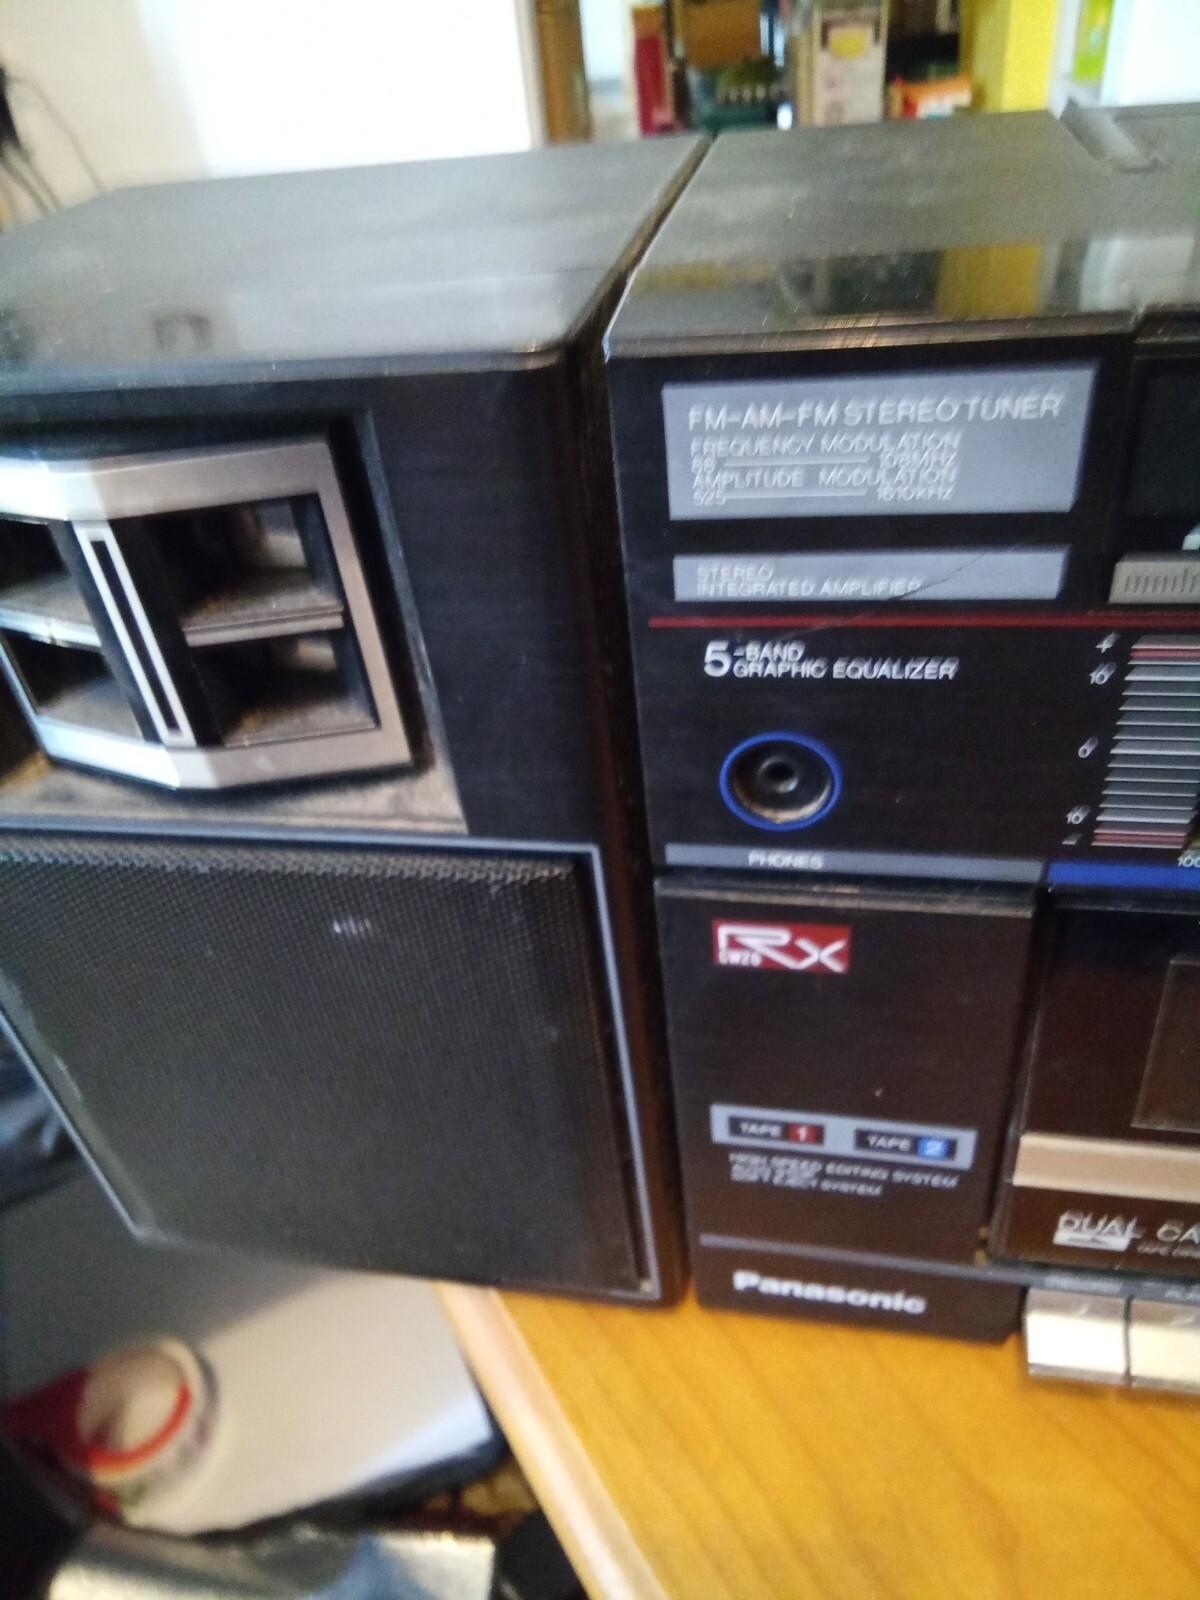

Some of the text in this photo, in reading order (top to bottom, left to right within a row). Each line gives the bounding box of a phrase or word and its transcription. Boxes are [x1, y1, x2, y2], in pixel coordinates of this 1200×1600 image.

[843, 394, 959, 427] STEREO
[961, 389, 1065, 422] TUNER
[691, 429, 962, 457] FREQUENCY MODULATION
[693, 462, 959, 489] AMPLITUDE MODULATION
[697, 565, 773, 582] STEREO
[697, 577, 923, 597] INTEGRATED AMPLIFIER
[733, 656, 960, 680] GRAPHIC EQUALIZER
[747, 851, 824, 871] PHONES
[739, 1120, 782, 1138] TAPE
[866, 1135, 910, 1152] TAPE
[1056, 1211, 1146, 1241] DUAL
[732, 1269, 927, 1315] Panasonic
